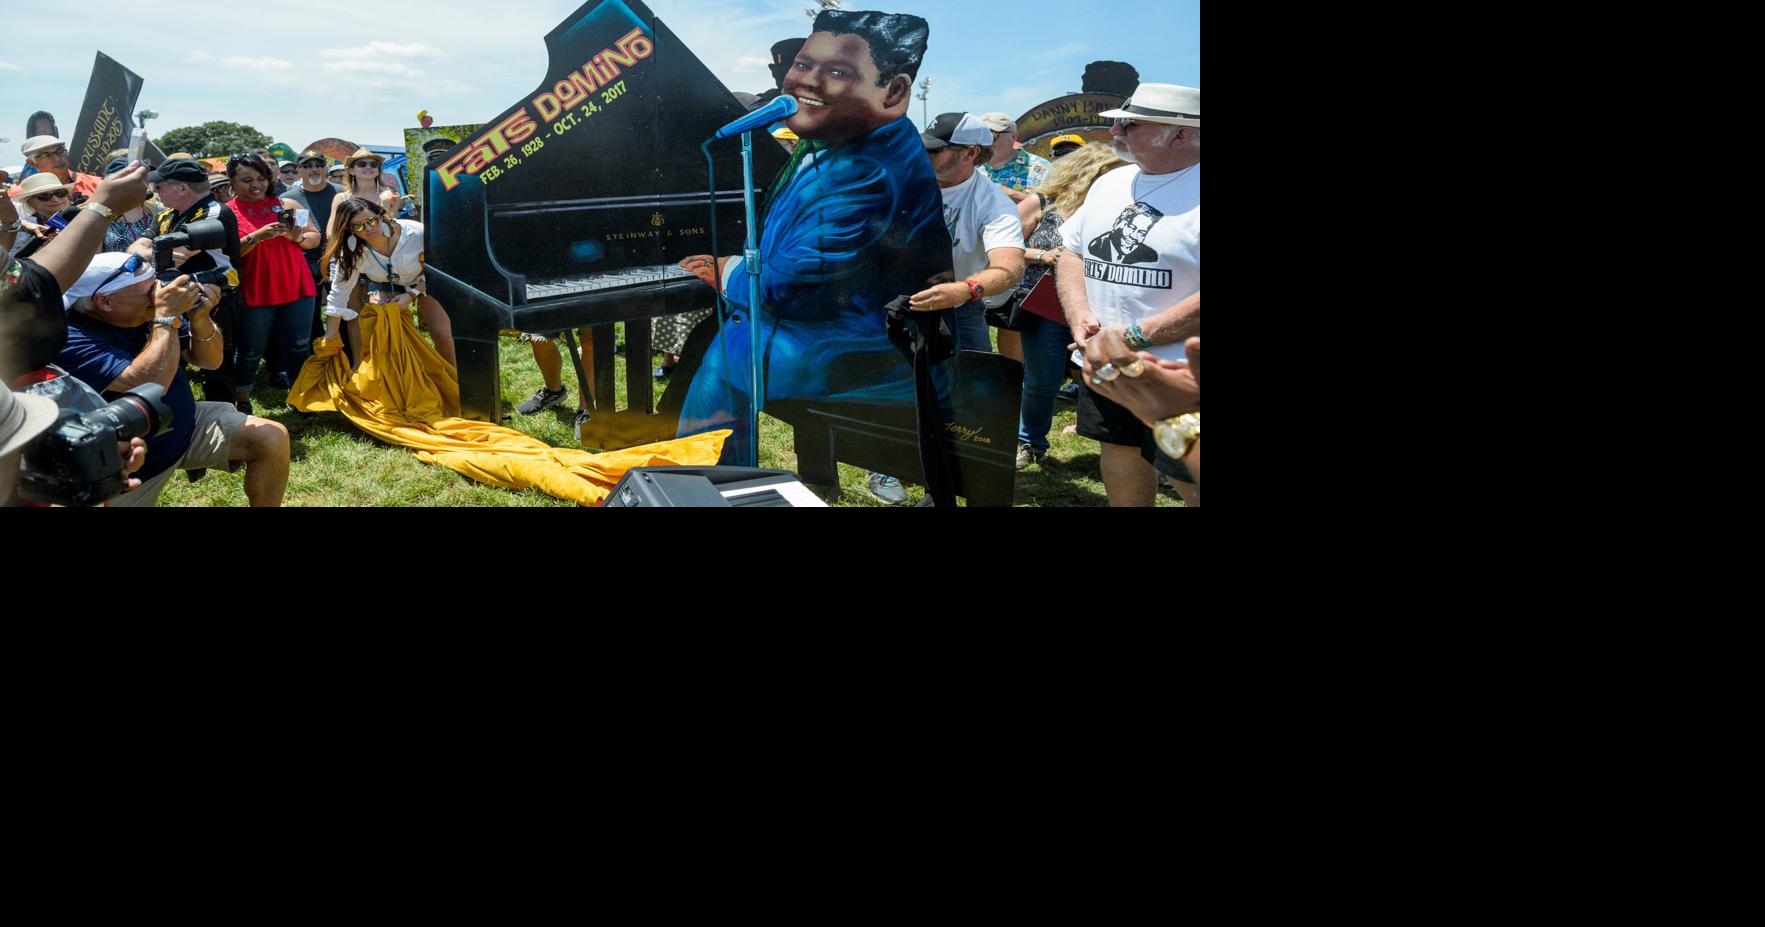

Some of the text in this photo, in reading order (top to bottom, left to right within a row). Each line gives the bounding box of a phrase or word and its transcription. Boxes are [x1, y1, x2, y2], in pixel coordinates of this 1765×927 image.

[1031, 101, 1078, 122] DANNY
[479, 164, 504, 185] FEB.
[503, 154, 522, 169] 26,
[521, 136, 545, 158] 1928
[553, 112, 582, 136] OCT.
[581, 101, 602, 118] 24,
[601, 80, 628, 104] 2017
[605, 230, 660, 241] STEINWAY
[679, 227, 705, 236] SONS
